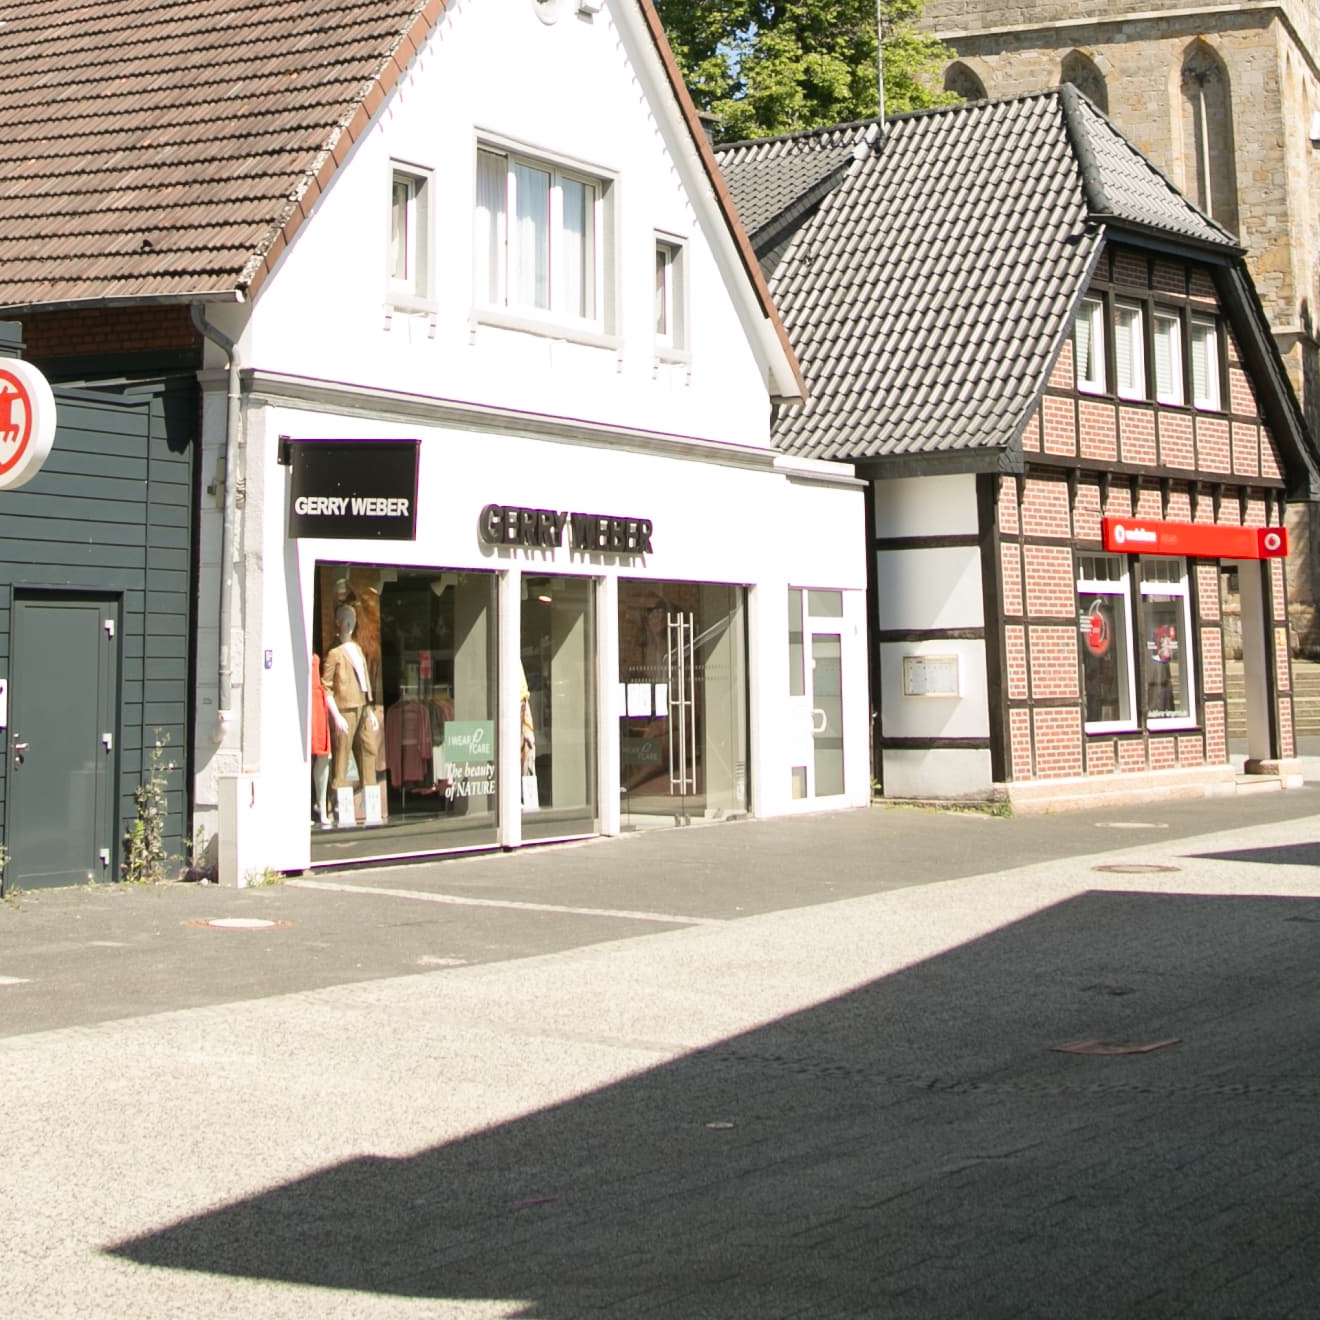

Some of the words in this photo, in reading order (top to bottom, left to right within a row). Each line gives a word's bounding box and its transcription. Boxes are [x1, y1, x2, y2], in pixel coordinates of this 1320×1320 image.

[294, 496, 349, 516] GERRY
[351, 497, 409, 517] WEBER
[479, 503, 568, 548] GERRY
[570, 512, 653, 555] WEBER
[464, 762, 495, 779] beauty
[456, 780, 495, 797] NATURE
